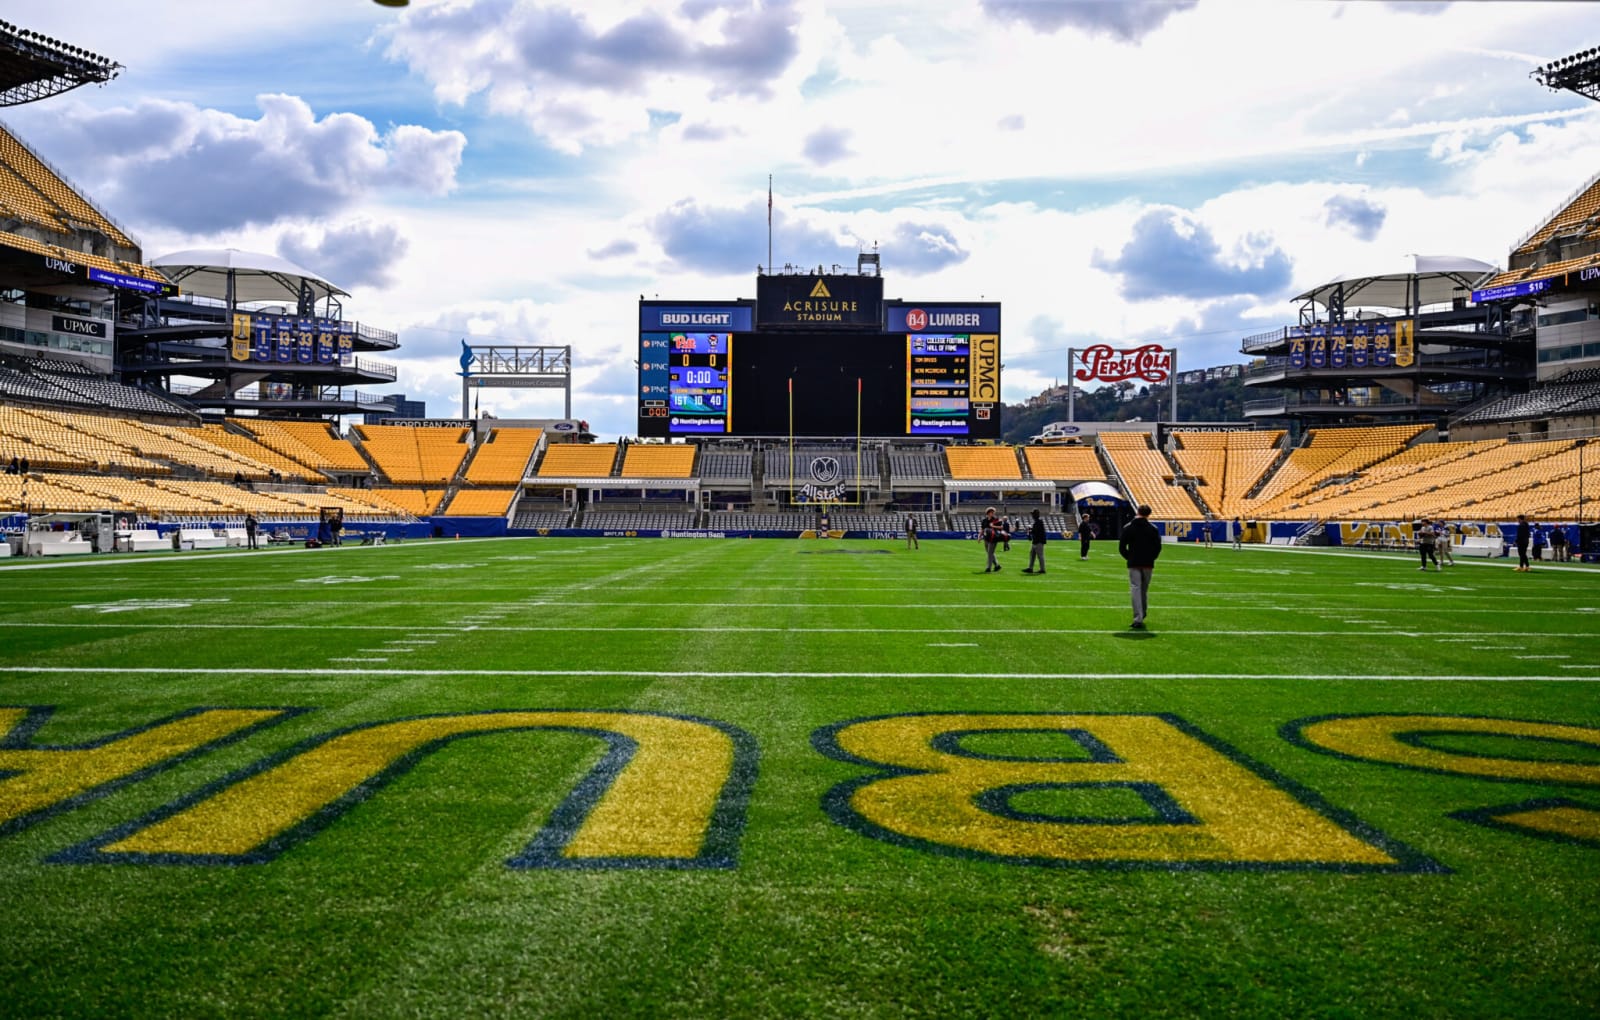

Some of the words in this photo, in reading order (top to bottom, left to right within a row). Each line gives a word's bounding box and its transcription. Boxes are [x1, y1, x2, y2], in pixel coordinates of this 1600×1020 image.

[45, 256, 76, 274] UPMC
[1487, 286, 1517, 295] Clearview
[783, 301, 858, 312] ACRISURE
[662, 314, 690, 324] BUD
[691, 314, 729, 324] LIGHT
[909, 315, 925, 326] 84
[929, 314, 980, 326] LUMBER
[63, 319, 99, 334] UPMC
[260, 330, 266, 345] 1
[279, 331, 290, 346] 13
[299, 332, 313, 347] 33
[320, 333, 333, 347] 42
[339, 334, 353, 349] 65
[651, 340, 668, 348] PNC
[1311, 336, 1326, 352] 73
[1331, 336, 1346, 351] 79
[1353, 335, 1368, 350] 89
[1374, 335, 1389, 349] 99
[1291, 338, 1305, 353] 75
[651, 362, 668, 370] PNC
[683, 354, 689, 367] 0
[710, 354, 716, 367] 0
[979, 338, 995, 399] UPMC
[687, 370, 711, 384] 0:00
[651, 385, 668, 393] PNC
[694, 396, 703, 406] 10
[710, 396, 721, 406] 40
[680, 418, 709, 426] Huntington
[921, 420, 951, 428] Huntington
[800, 482, 846, 500] Allstate
[670, 530, 704, 539] Huntington
[707, 530, 727, 538] Bank
[867, 531, 895, 540] UPMC
[1164, 522, 1193, 538] H2P
